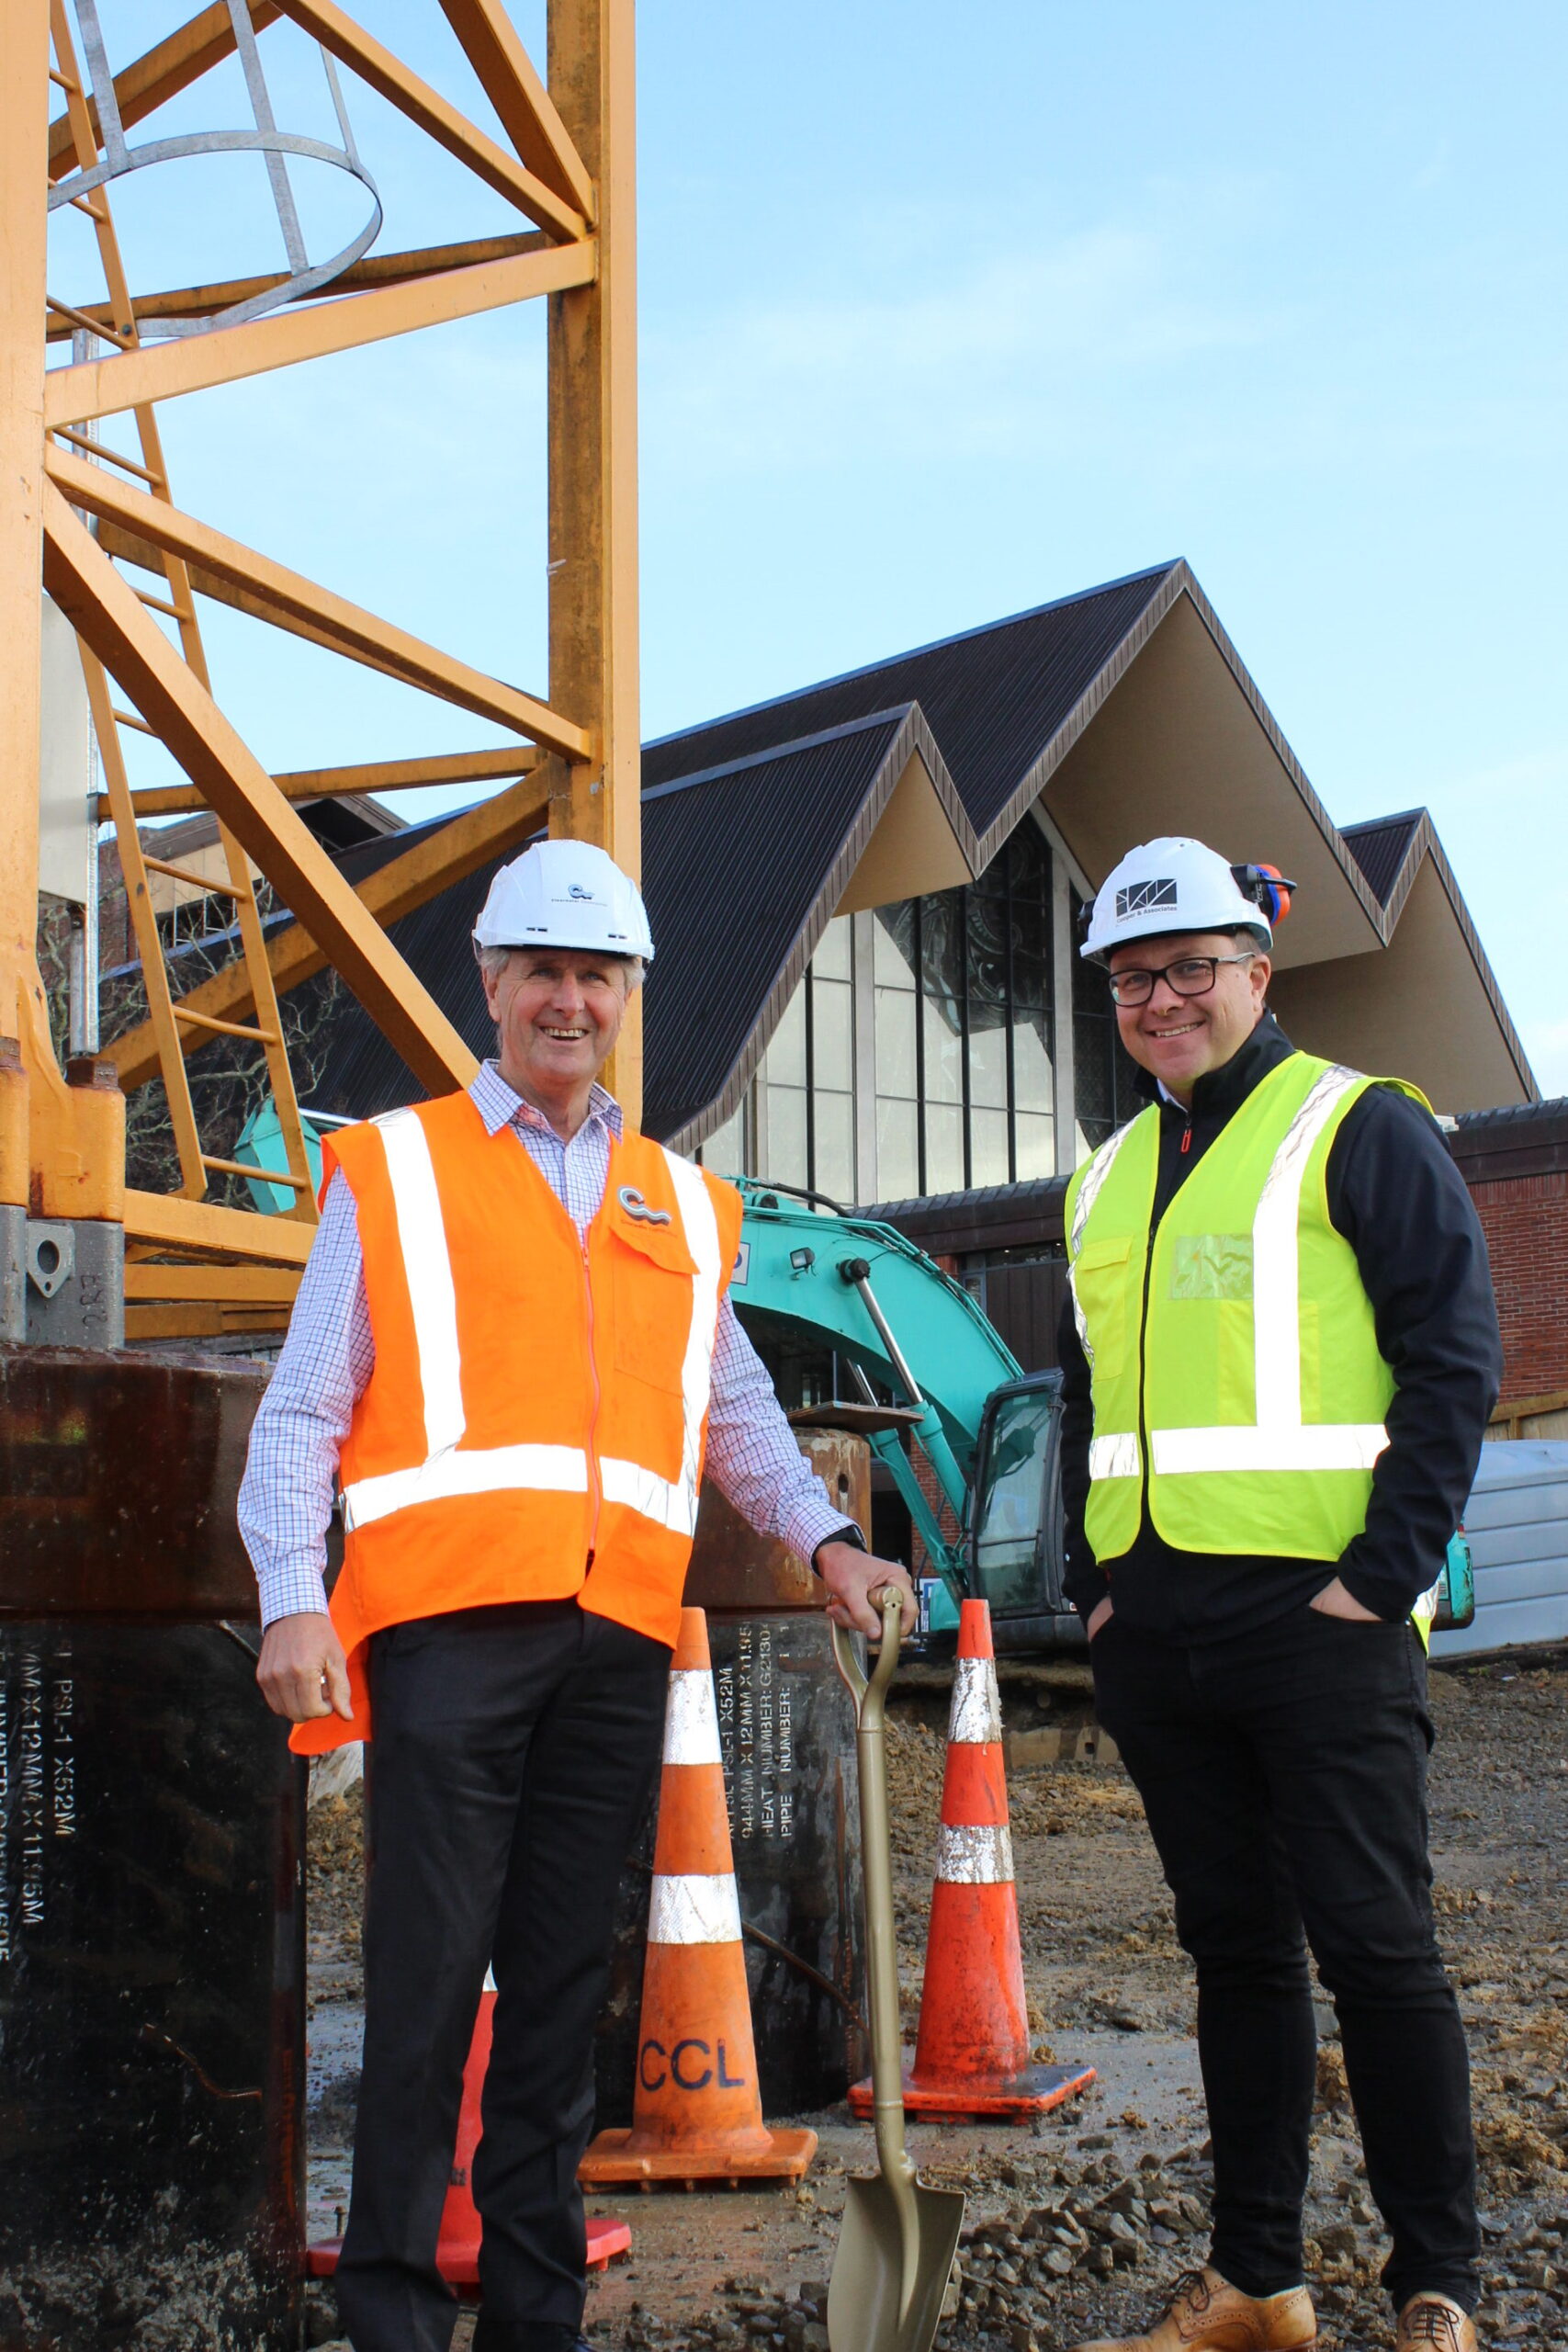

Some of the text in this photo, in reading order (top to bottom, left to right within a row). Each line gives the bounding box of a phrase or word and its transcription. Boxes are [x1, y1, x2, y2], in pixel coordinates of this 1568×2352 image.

[1143, 906, 1177, 914] Associates
[718, 1667, 734, 1724] X52M
[760, 1690, 773, 1775] NUMBER:
[778, 1687, 792, 1772] NUMBER:
[54, 1757, 75, 1835] X52M
[740, 1769, 754, 1839] 944MM
[761, 1787, 774, 1838] HEAT
[780, 1795, 793, 1838] PIPE
[639, 2038, 746, 2093] CCL
